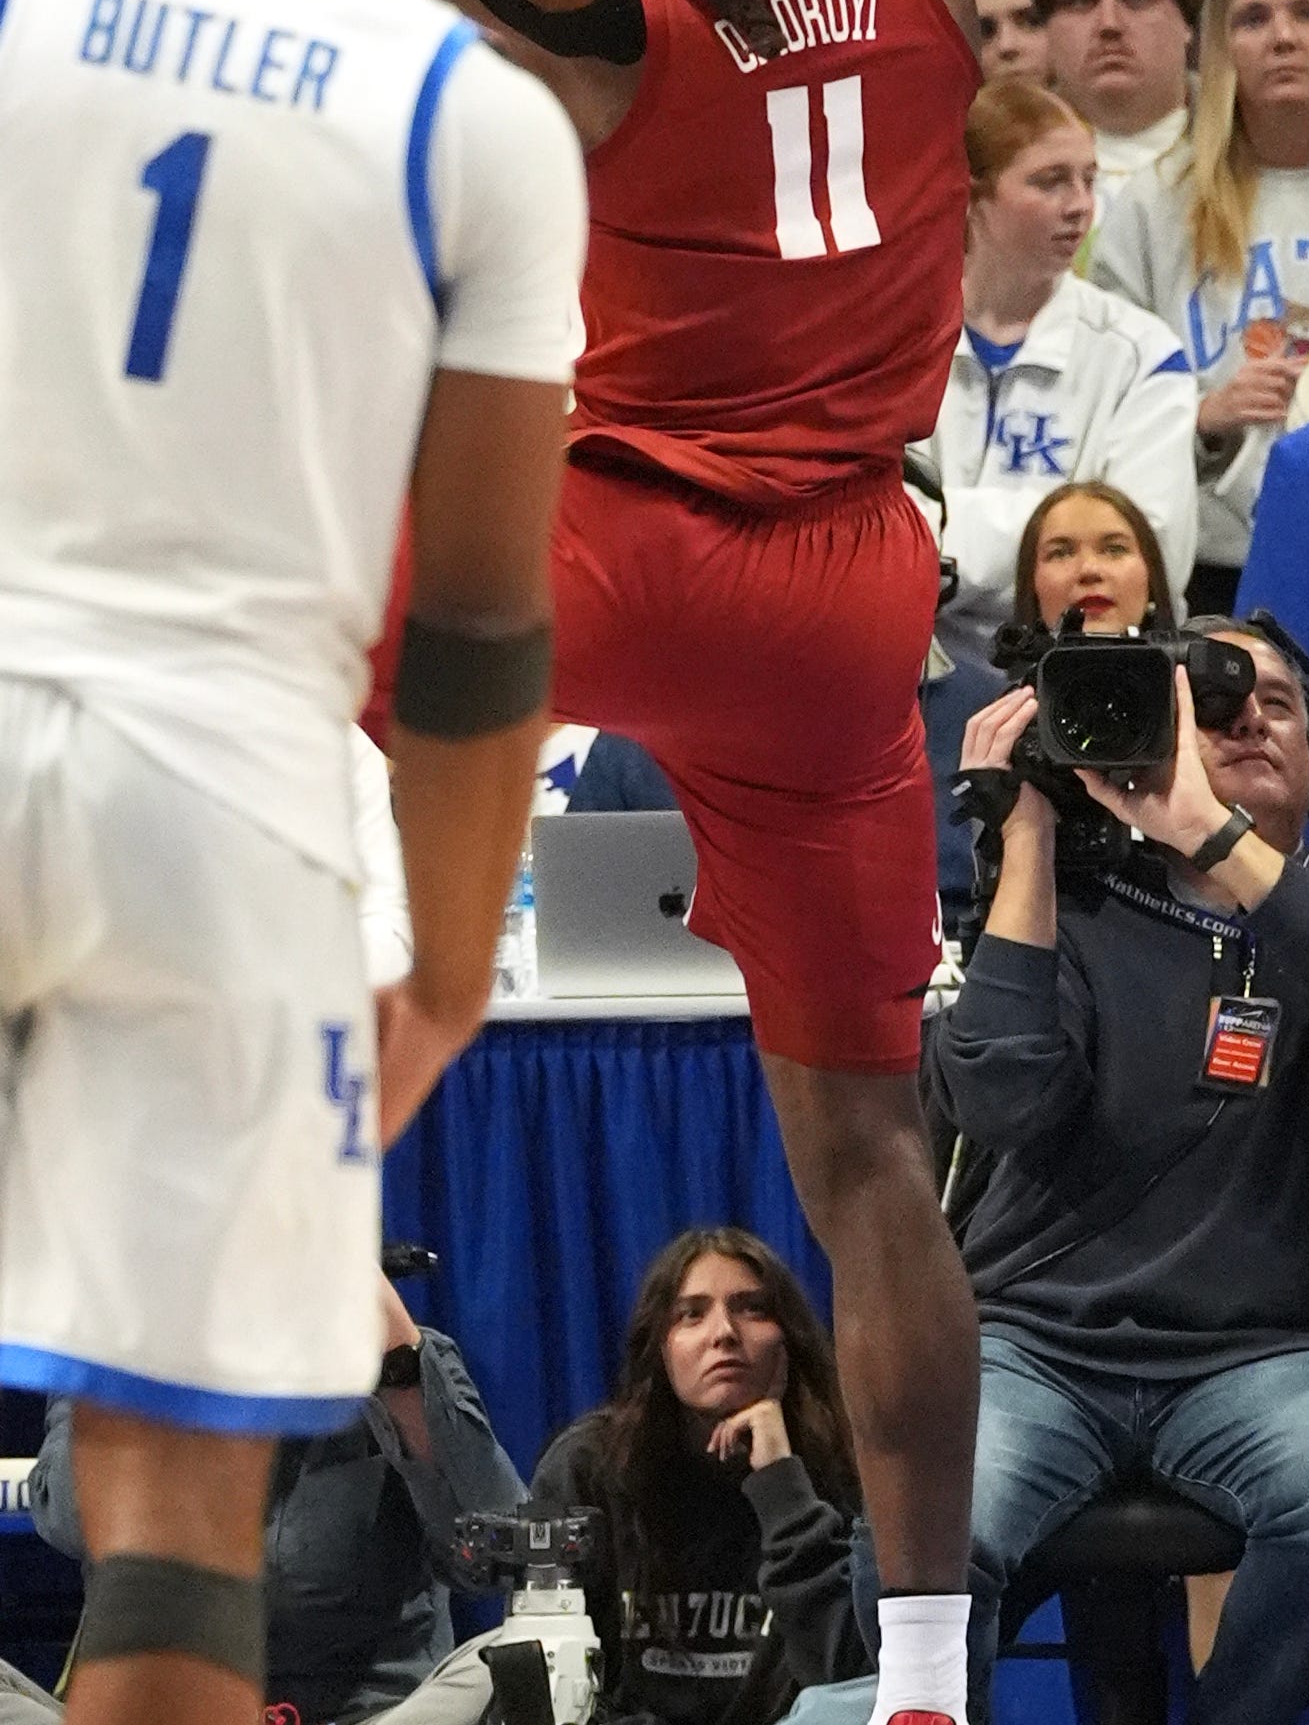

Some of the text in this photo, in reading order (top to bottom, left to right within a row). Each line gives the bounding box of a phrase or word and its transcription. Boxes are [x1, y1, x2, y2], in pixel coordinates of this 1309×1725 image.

[123, 129, 214, 383] 1
[765, 74, 882, 261] 11
[995, 411, 1074, 476] UK
